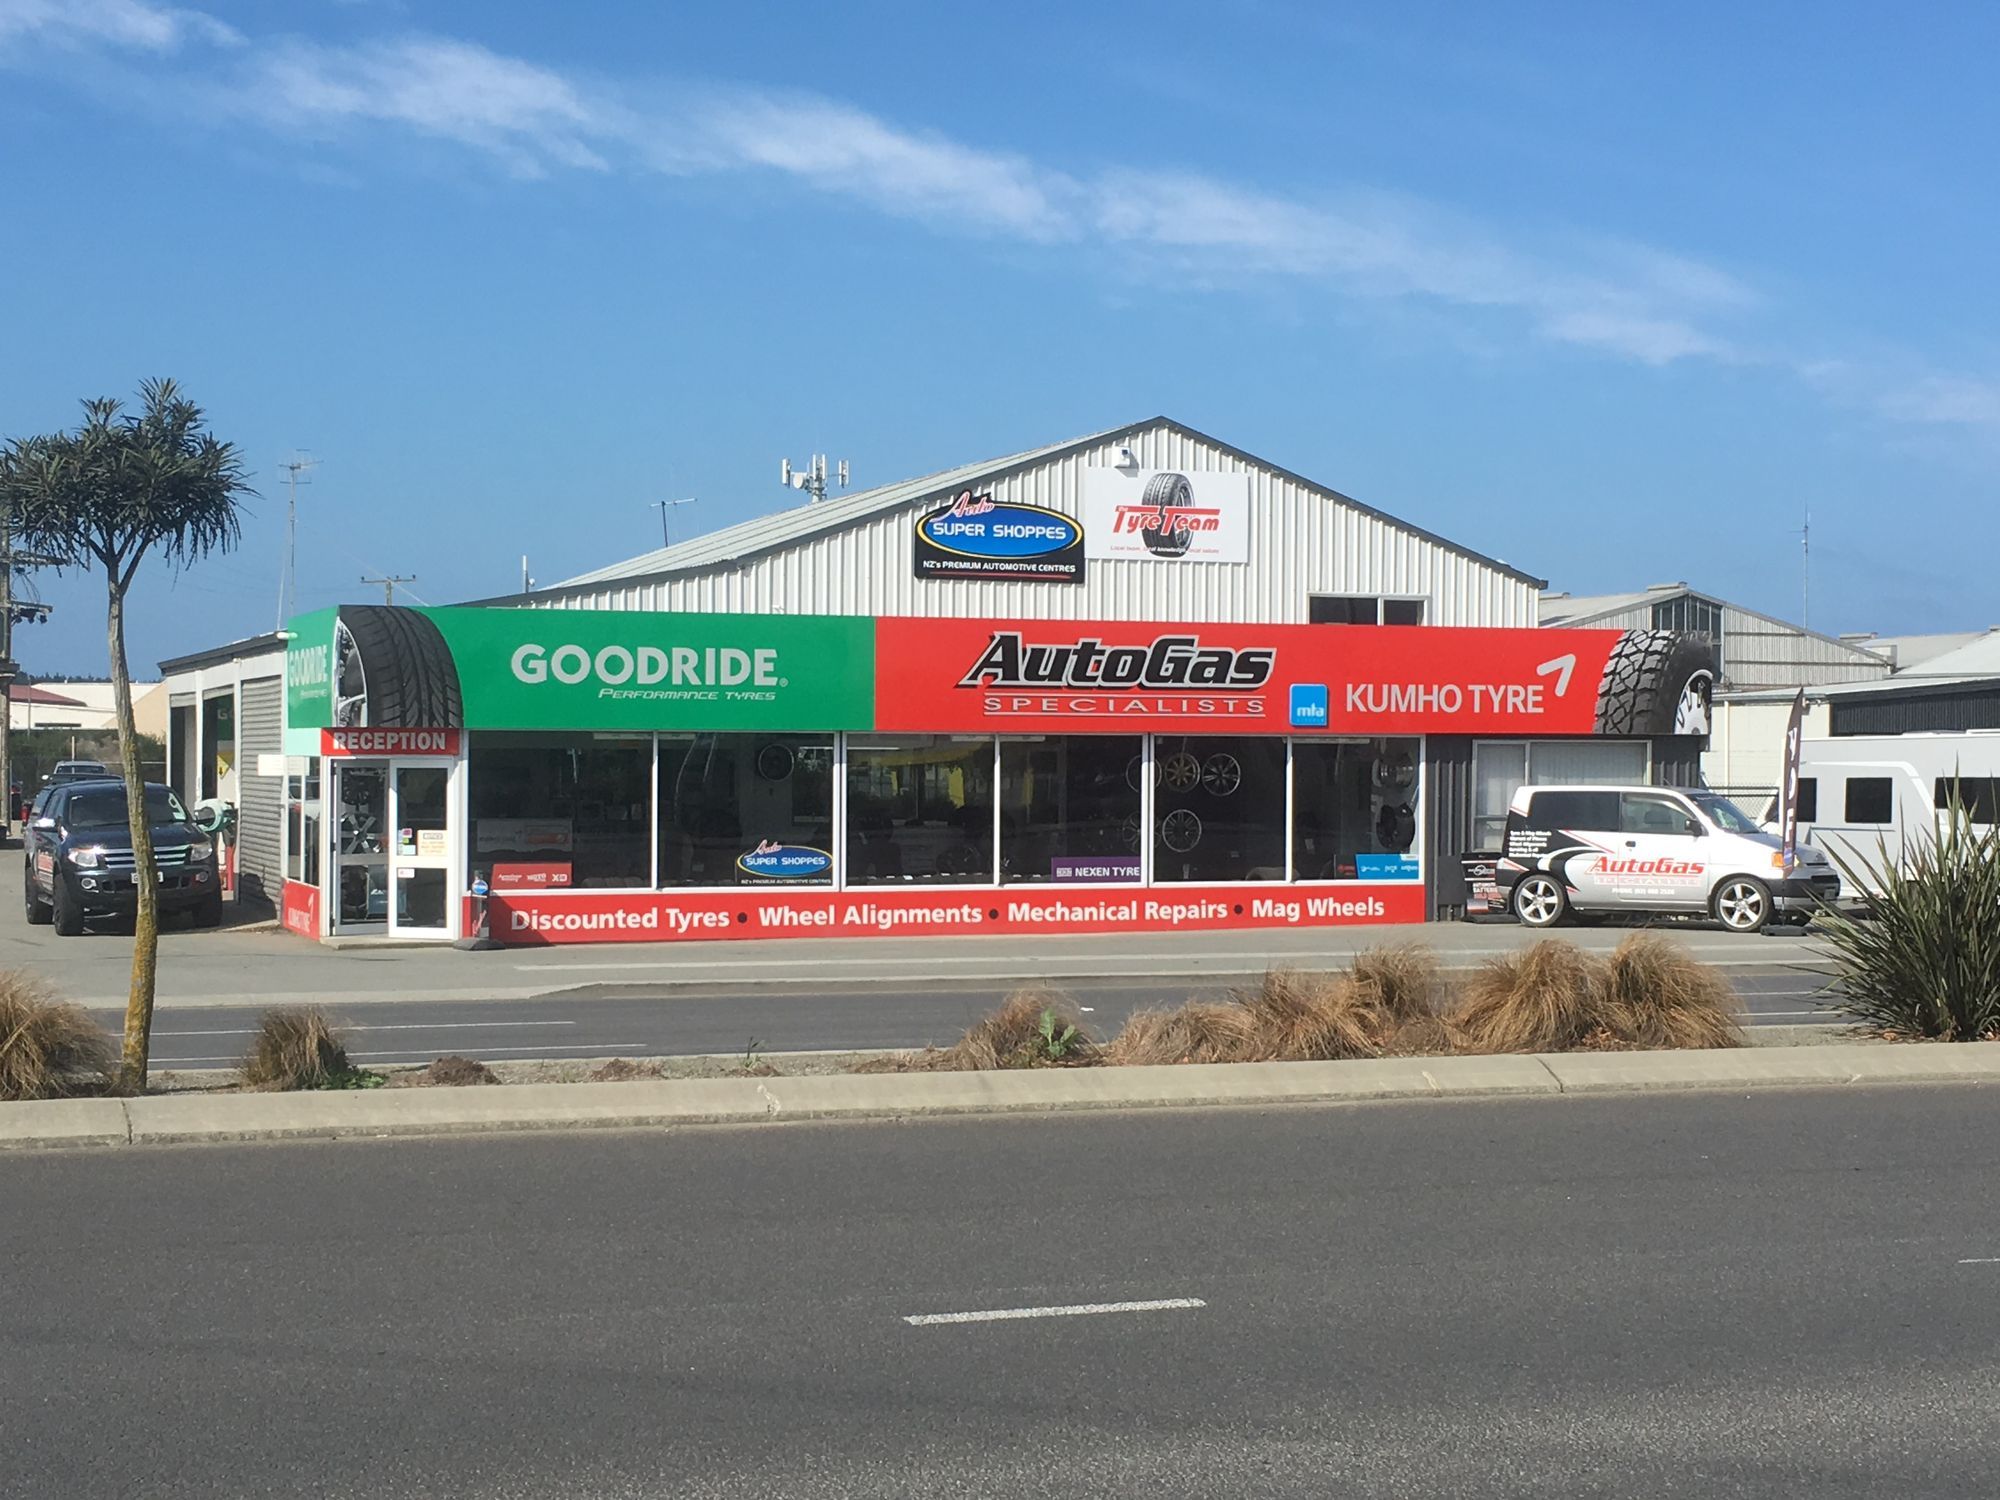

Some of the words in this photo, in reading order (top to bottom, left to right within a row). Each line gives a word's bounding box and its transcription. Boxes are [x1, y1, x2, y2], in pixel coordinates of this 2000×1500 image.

[1112, 505, 1160, 534] Tyre
[1160, 507, 1221, 535] Team
[933, 522, 985, 537] SUPER
[993, 524, 1067, 540] SHOPPES
[923, 560, 941, 568] NZ's
[942, 561, 981, 570] PREMIUM
[983, 561, 1037, 571] AUTOMOTIVE
[1038, 564, 1076, 573] CENTRES
[511, 644, 779, 686] GOODRIDE
[954, 631, 1277, 690] AutoGas
[598, 688, 719, 701] PERFORMANCE
[725, 691, 777, 702] TYRES
[984, 697, 1265, 713] SPECIALISTS
[1346, 684, 1462, 713] KUMHO
[1468, 685, 1544, 714] TYRE
[333, 731, 446, 751] RECEPTION
[746, 856, 777, 866] SUPER
[781, 856, 825, 866] SHOPPES
[1584, 855, 1706, 876] AutoGas
[1075, 867, 1110, 877] NEXEN
[1112, 866, 1140, 877] TYRE
[511, 907, 658, 931] Discounted
[665, 907, 730, 933] Tyres
[758, 905, 835, 926] Wheel
[843, 904, 982, 930] Alignments
[1007, 901, 1137, 922] Mechanical
[1145, 899, 1228, 924] Repairs
[1252, 899, 1301, 923] Mag
[1307, 897, 1385, 917] Wheels
